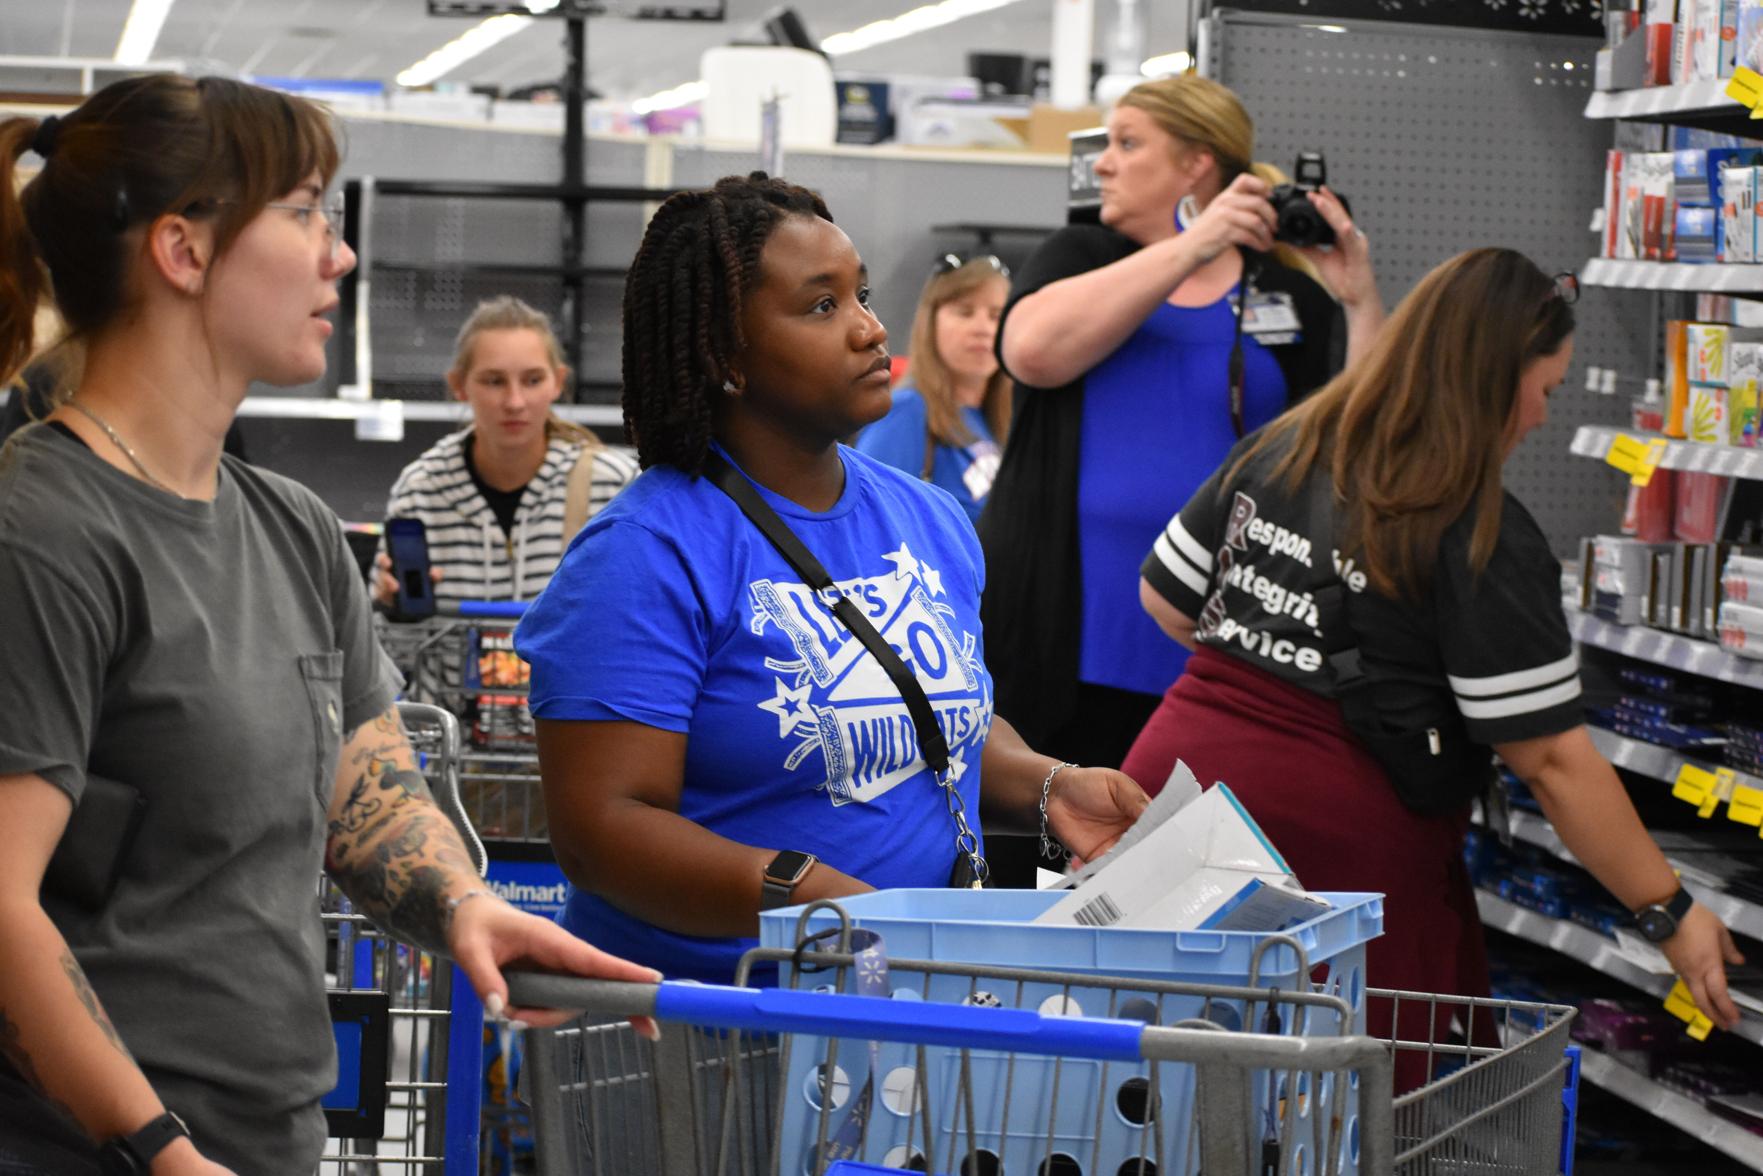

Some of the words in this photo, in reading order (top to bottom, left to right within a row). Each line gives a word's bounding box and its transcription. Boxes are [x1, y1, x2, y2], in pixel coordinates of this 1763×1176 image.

[1225, 491, 1367, 594] Responle
[788, 583, 888, 660] LE'S
[1217, 544, 1323, 638] Integrit
[890, 620, 949, 680] O
[847, 705, 972, 788] WILDATS
